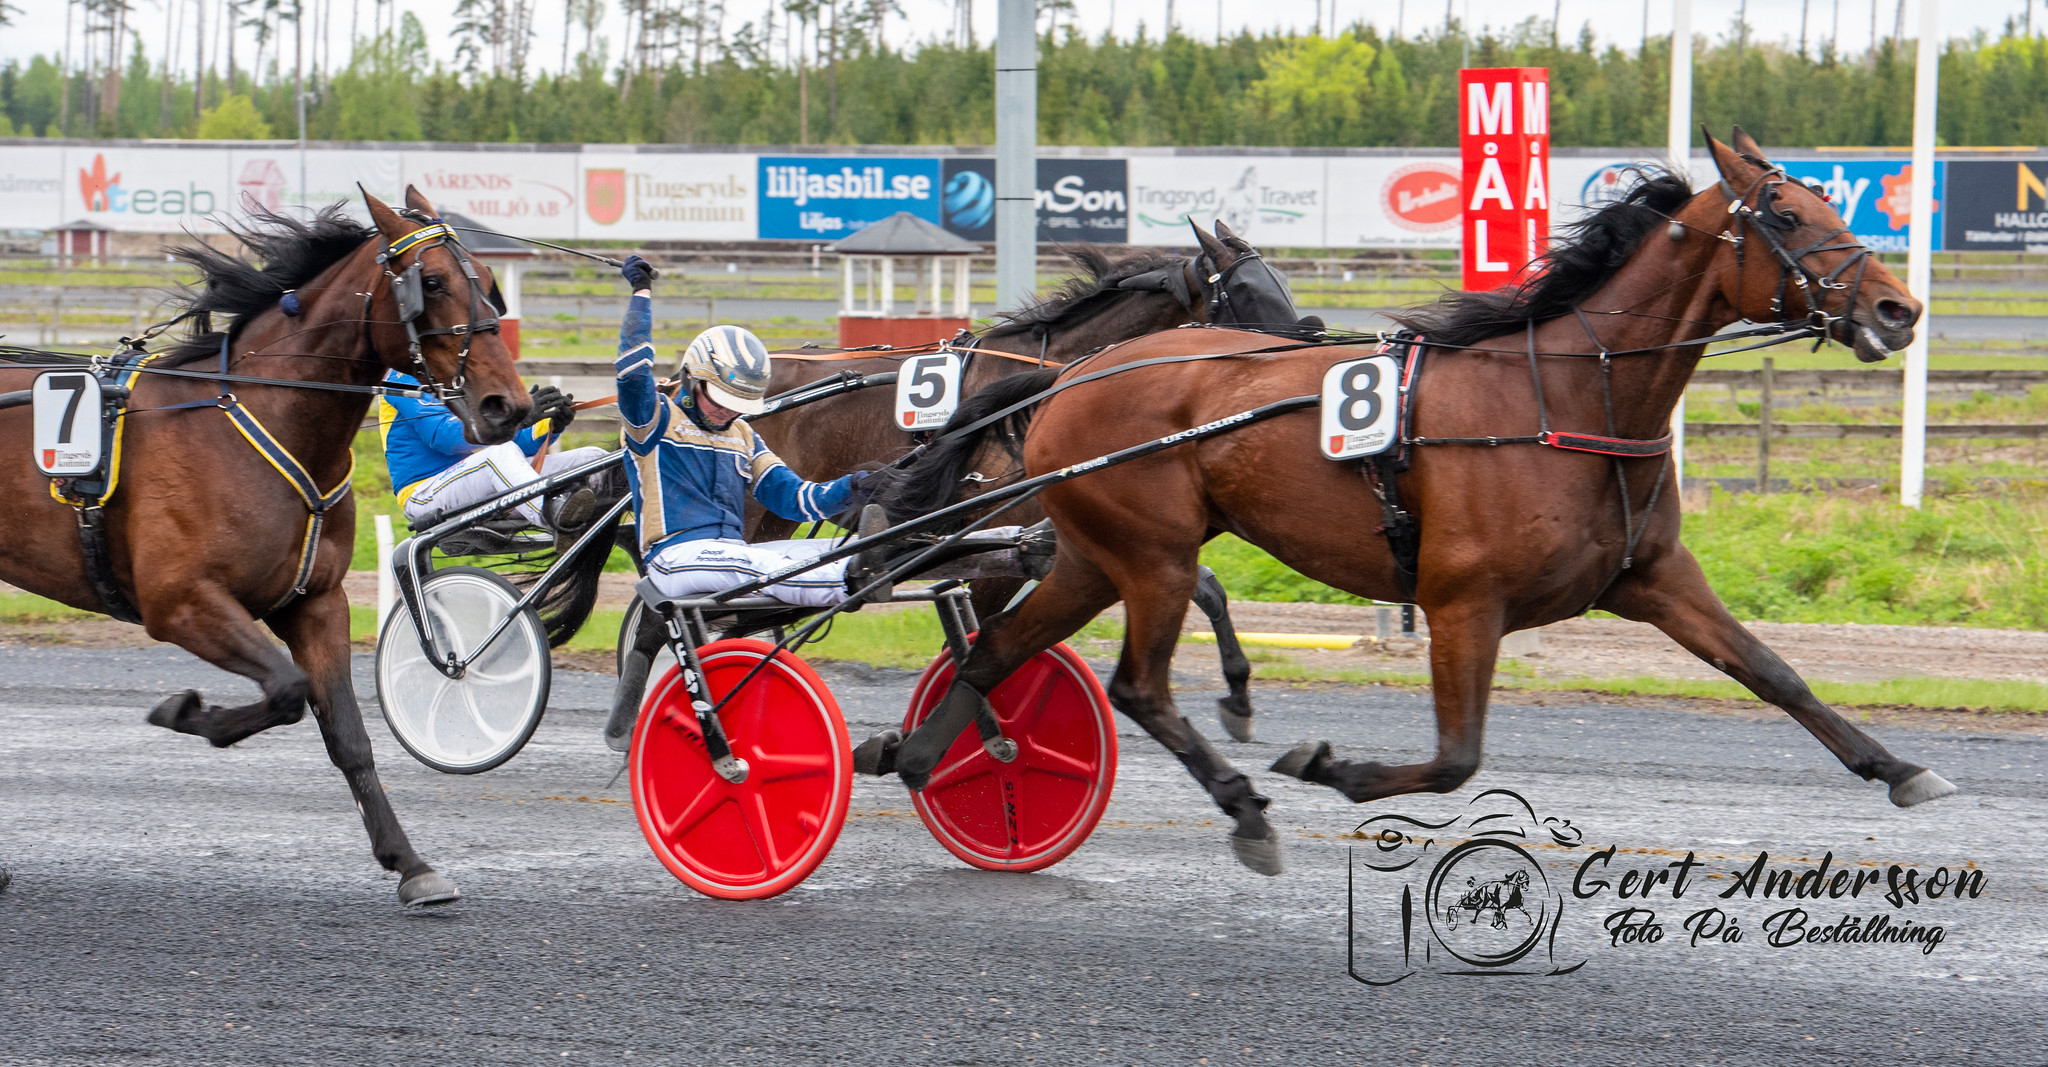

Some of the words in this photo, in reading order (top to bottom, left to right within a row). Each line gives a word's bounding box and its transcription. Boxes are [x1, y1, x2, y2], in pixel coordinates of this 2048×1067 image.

[424, 169, 511, 190] VÄRENDS
[627, 173, 746, 204] Tingsryds
[766, 166, 930, 206] liljasbil.se
[1468, 82, 1514, 271] MÅL
[107, 181, 214, 214] teab
[468, 196, 529, 218] MILJÖ
[535, 200, 559, 217] AB
[635, 198, 744, 222] kommun
[1136, 186, 1215, 211] Tingsryd
[1259, 186, 1317, 206] Travet
[908, 356, 947, 409] 5
[1339, 362, 1382, 431] 8
[48, 375, 86, 443] 7
[499, 479, 549, 507] CUSTOM
